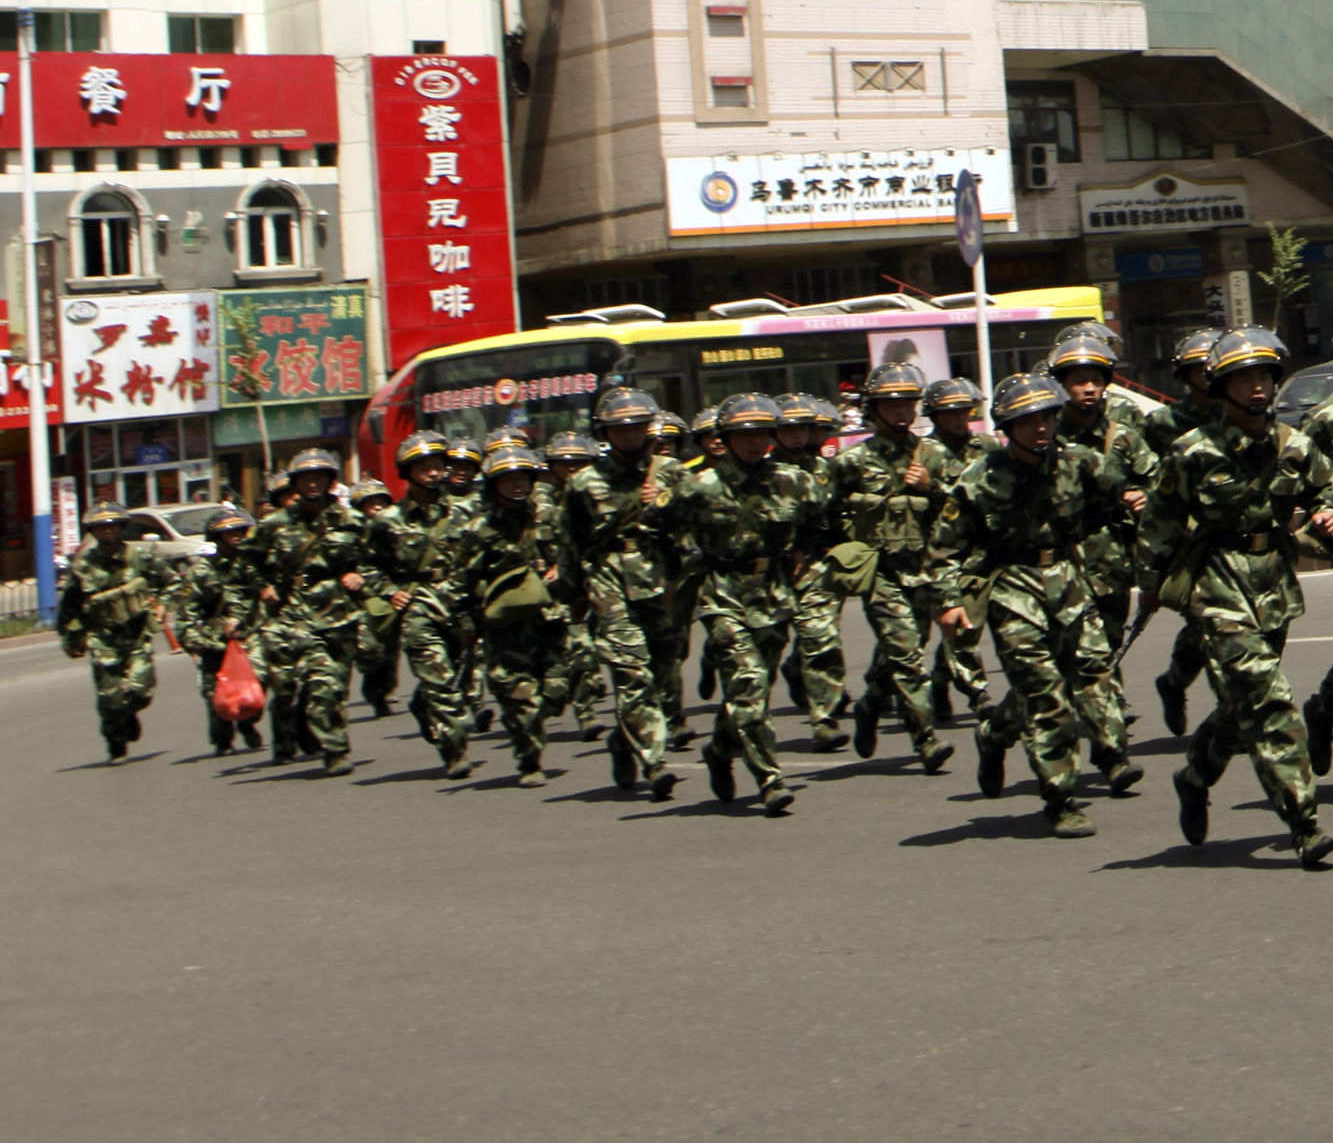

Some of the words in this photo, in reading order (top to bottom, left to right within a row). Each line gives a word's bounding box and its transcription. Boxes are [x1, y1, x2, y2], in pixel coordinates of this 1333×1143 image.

[821, 203, 848, 213] CITY
[854, 198, 932, 211] COMMERCIAL
[259, 313, 332, 336] 和平
[228, 335, 363, 396] 水饺馆
